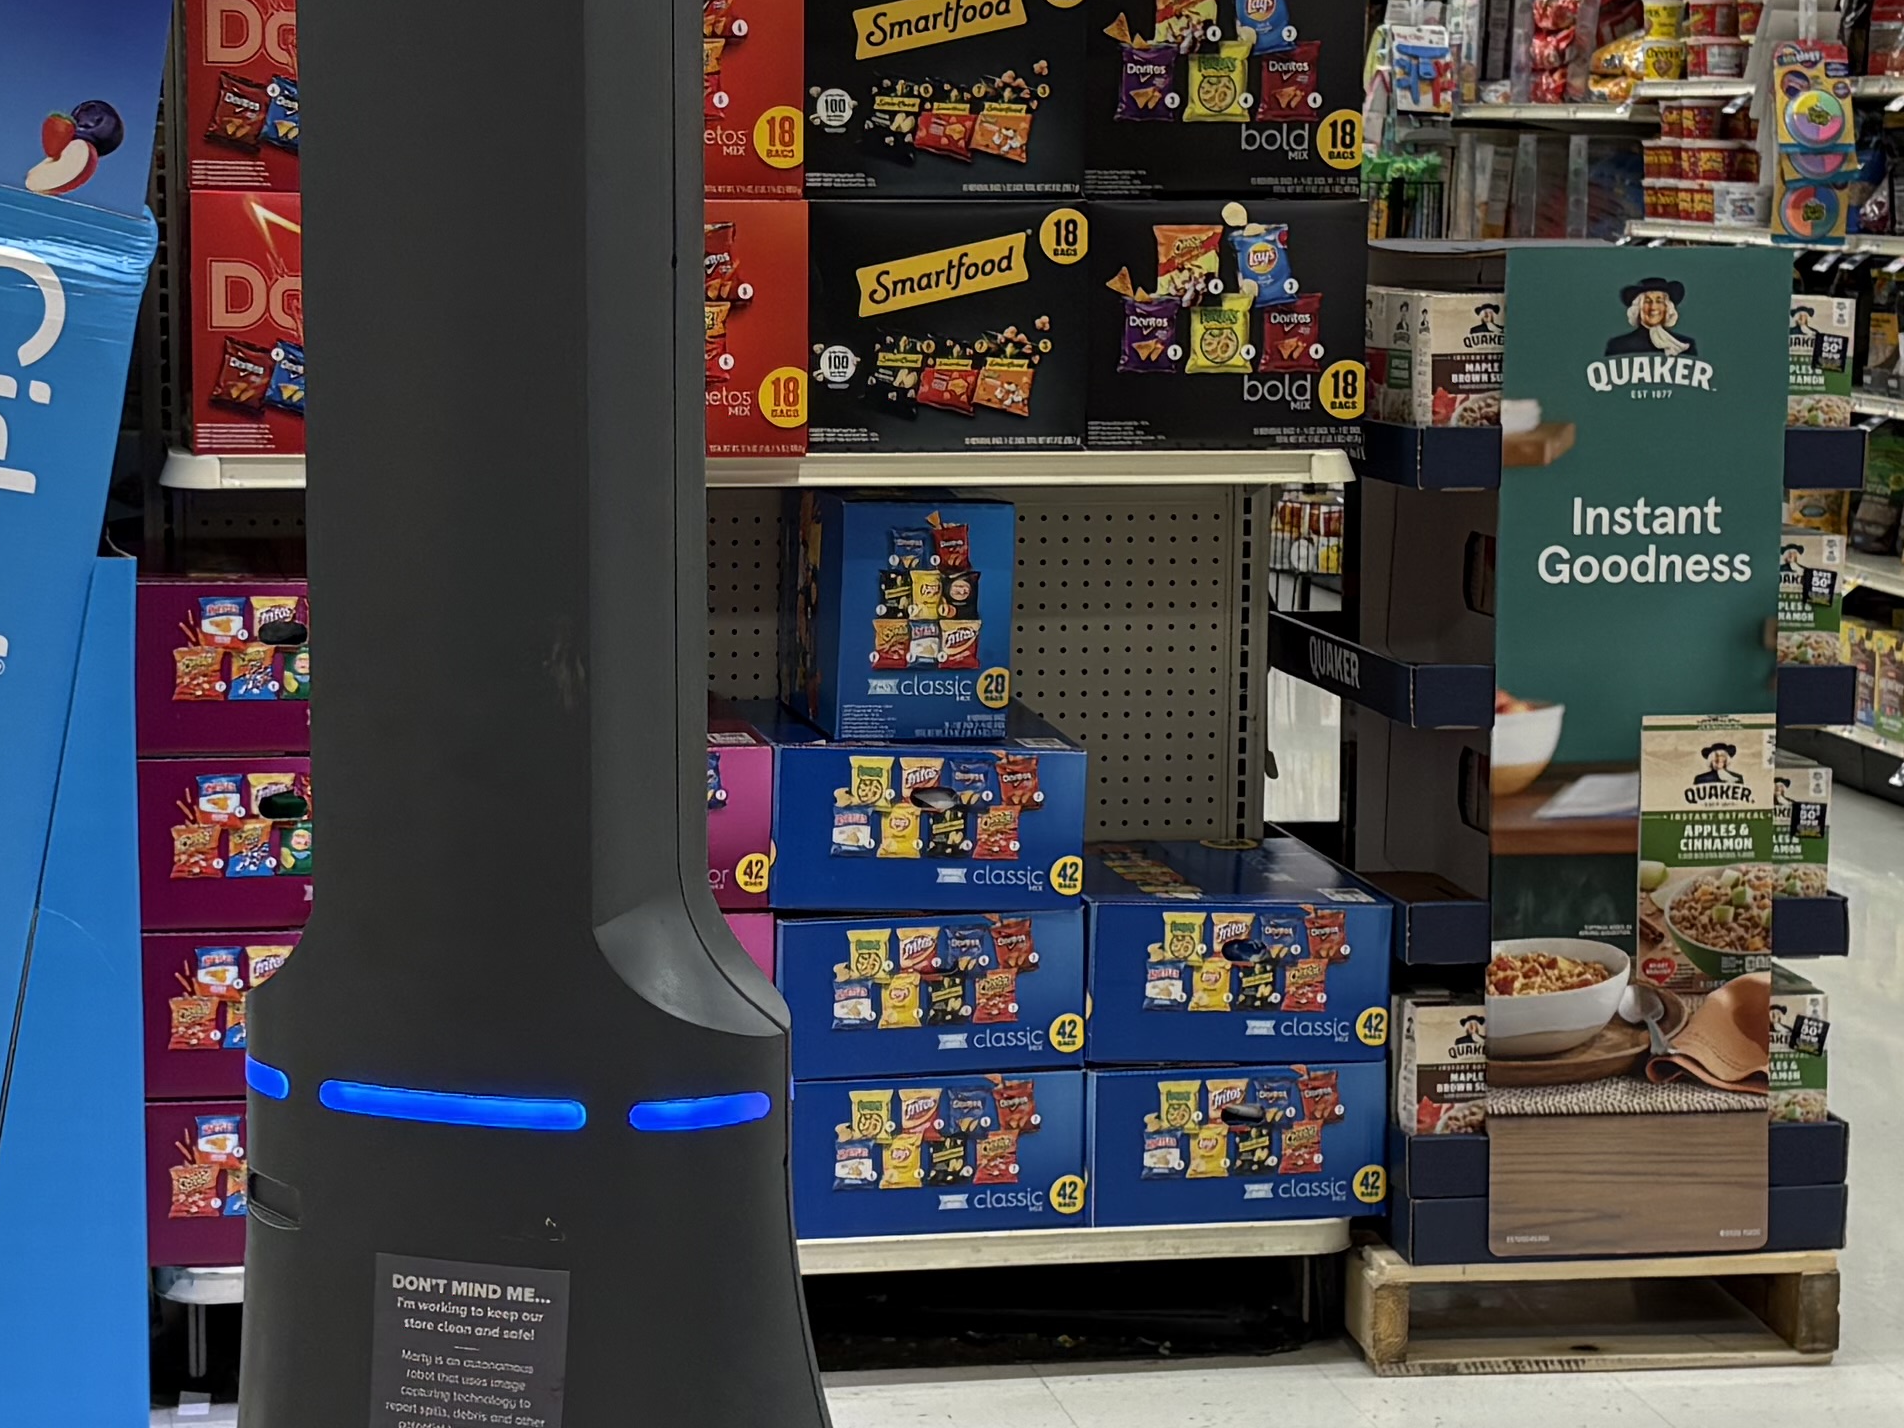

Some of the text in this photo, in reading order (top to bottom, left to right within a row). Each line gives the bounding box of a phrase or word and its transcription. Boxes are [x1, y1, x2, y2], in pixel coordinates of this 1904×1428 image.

[1127, 63, 1166, 75] Doritos
[1240, 123, 1309, 152] bold
[1326, 118, 1357, 149] 18
[1288, 149, 1309, 160] MIX
[868, 251, 1014, 306] Smartfood
[1465, 362, 1499, 373] MAPLE
[1586, 355, 1713, 393] QUAKER
[1243, 374, 1311, 403] bold
[1572, 496, 1722, 536] Instant
[1538, 544, 1752, 585] Goodness
[1308, 635, 1359, 690] QUAKER
[901, 675, 971, 696] classic
[984, 674, 1005, 694] 28
[1684, 782, 1753, 806] QUAKER
[1683, 823, 1749, 838] APPLES &
[1679, 835, 1753, 852] CINNAMON
[973, 866, 1043, 886] classic
[1057, 862, 1079, 882] 42
[1054, 1021, 1078, 1042] 42
[392, 1273, 447, 1295] DON'T
[452, 1280, 502, 1300] MIND
[418, 1300, 467, 1318] working
[471, 1304, 484, 1318] to
[487, 1306, 518, 1323] keep
[522, 1311, 544, 1324] our
[404, 1316, 535, 1341] store clean and safe!
